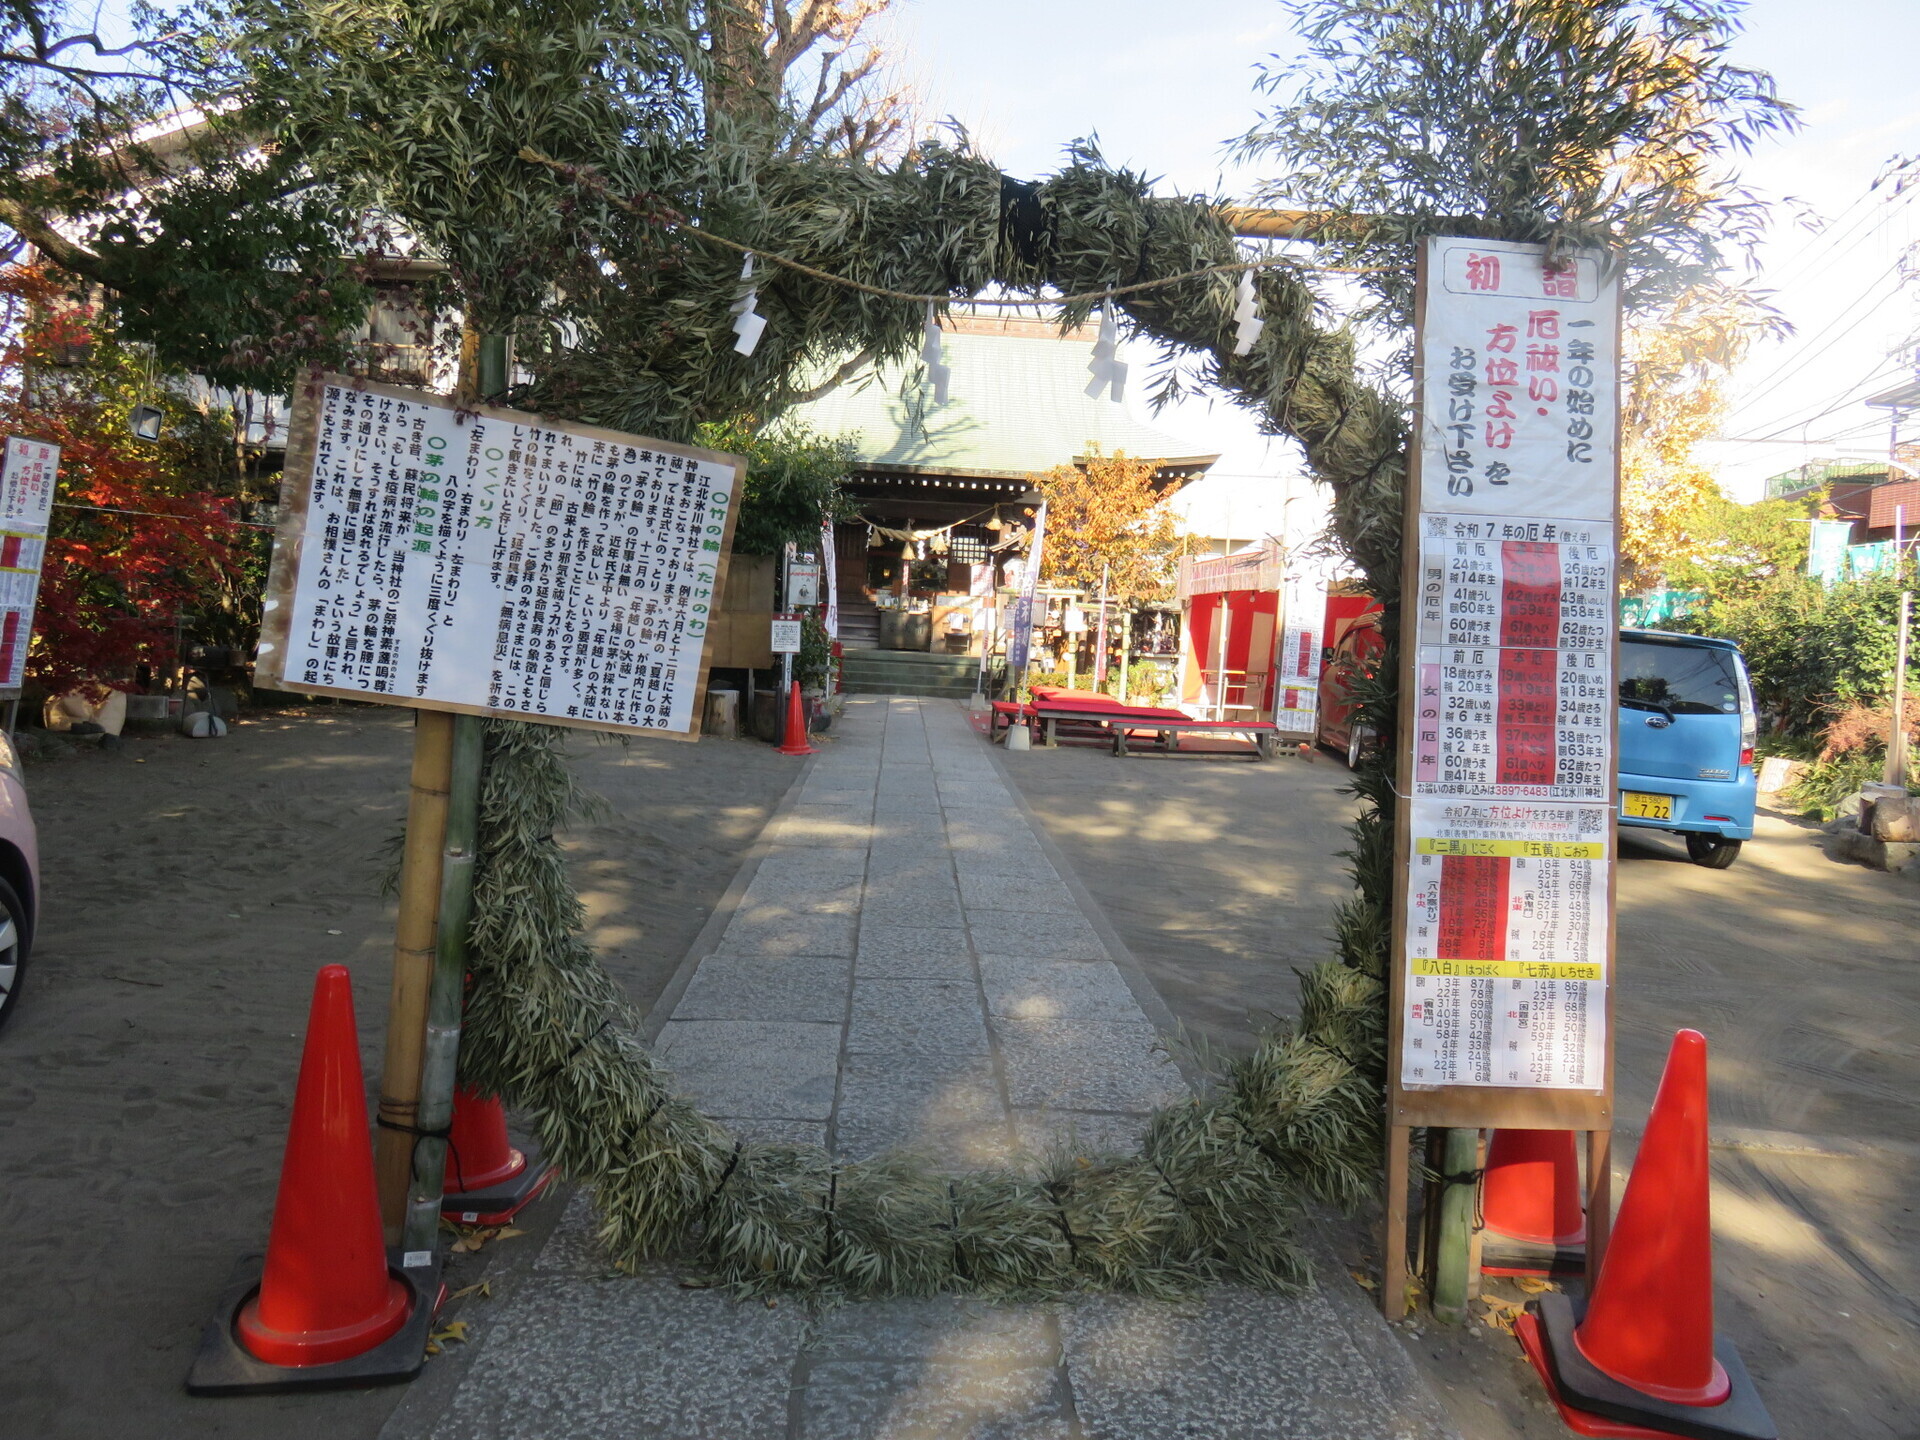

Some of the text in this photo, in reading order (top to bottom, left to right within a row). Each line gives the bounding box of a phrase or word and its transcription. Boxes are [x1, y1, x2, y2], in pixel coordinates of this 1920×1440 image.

[1566, 318, 1595, 463] 一年の始めに
[1447, 346, 1477, 497] お受け下さい
[310, 387, 341, 509] 源ともされています。
[487, 425, 525, 589] して戴きたいと存じ上げます。
[413, 474, 460, 697] 八の字を描くように三度くぐり抜けます
[1424, 567, 1442, 622] 男の厄年
[1449, 617, 1490, 632] 60歳うま
[1562, 621, 1604, 636] 62歳たつ
[1453, 649, 1484, 664] 前厄
[1566, 653, 1595, 668] 後厄
[1419, 685, 1438, 766] 女の厄年
[1444, 754, 1486, 769] 60歳うま
[1558, 757, 1601, 773] 62歳たつ
[1415, 892, 1426, 907] 中央
[1511, 896, 1522, 910] 北東
[1411, 1003, 1422, 1019] 南西
[1506, 1010, 1517, 1018] 北
